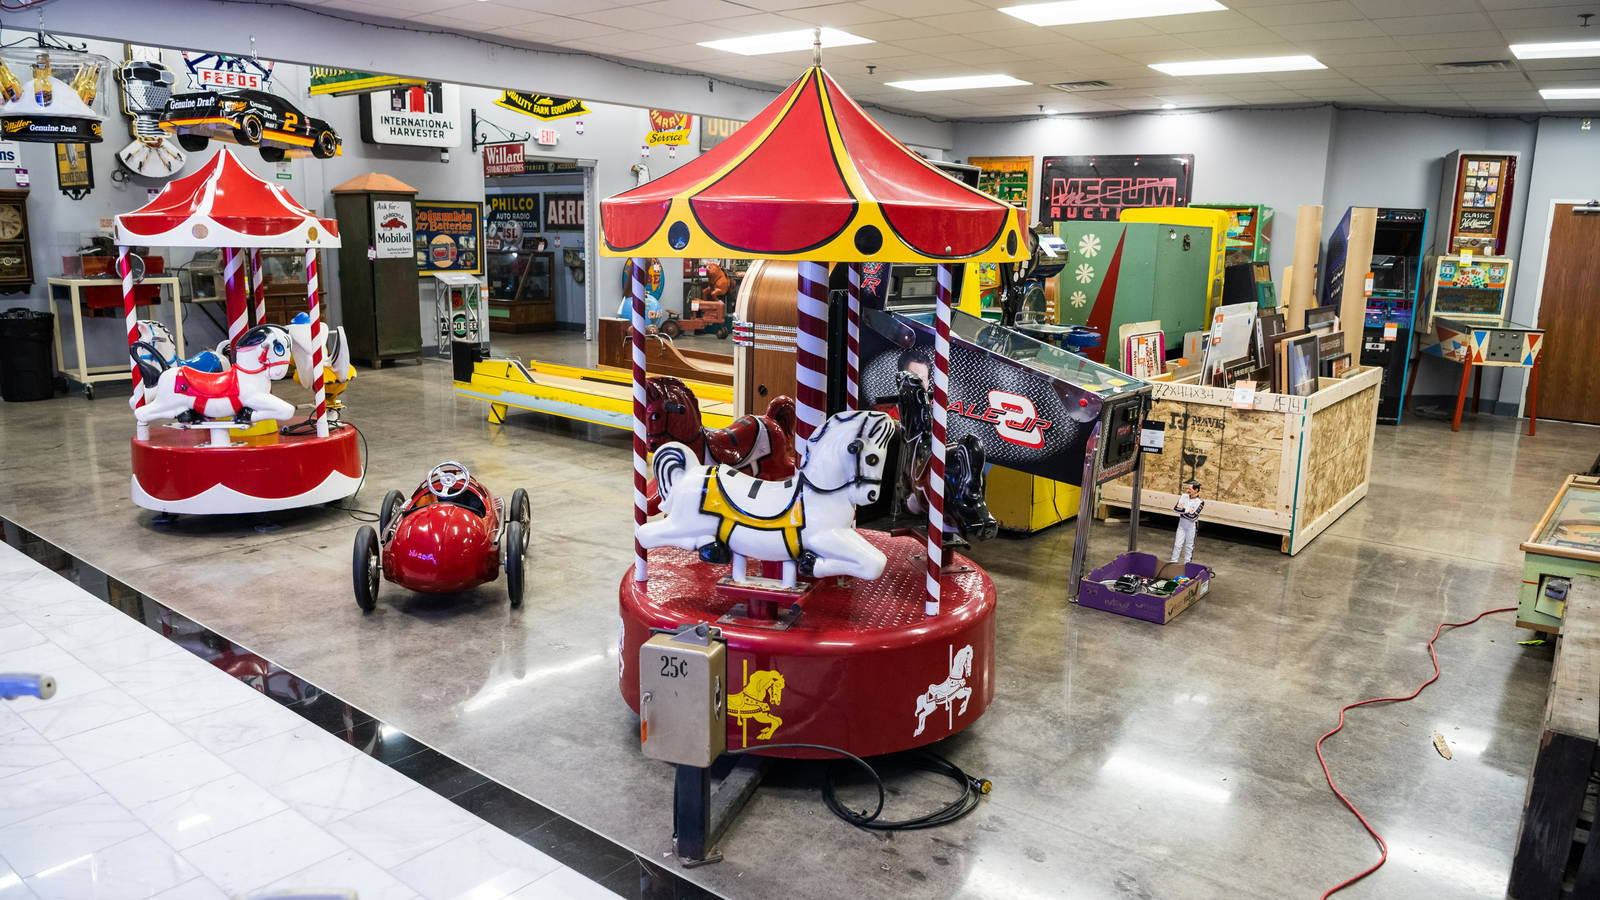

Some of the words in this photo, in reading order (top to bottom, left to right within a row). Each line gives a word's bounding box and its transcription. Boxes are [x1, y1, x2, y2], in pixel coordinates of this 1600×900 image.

[203, 71, 257, 88] FEEDS
[170, 99, 196, 110] Genuine
[197, 97, 215, 107] Draft
[506, 90, 531, 111] QUALITY
[533, 104, 549, 115] FARM
[263, 111, 277, 121] Draft
[282, 112, 298, 132] 2
[3, 120, 32, 133] Miller
[30, 124, 59, 132] Genuine
[381, 116, 454, 130] INTERNATIONAL
[390, 126, 445, 139] HARVESTER
[541, 129, 555, 143] EXIT
[649, 133, 683, 143] Service
[485, 145, 524, 165] Willard
[1052, 178, 1177, 207] MECUM
[376, 202, 387, 210] Ask
[491, 197, 534, 210] PHILCO
[430, 220, 472, 232] Batteries
[378, 232, 411, 243] Mobiloil
[945, 400, 1007, 425] ALE
[1005, 417, 1053, 433] JR
[660, 655, 689, 678] 25¢
